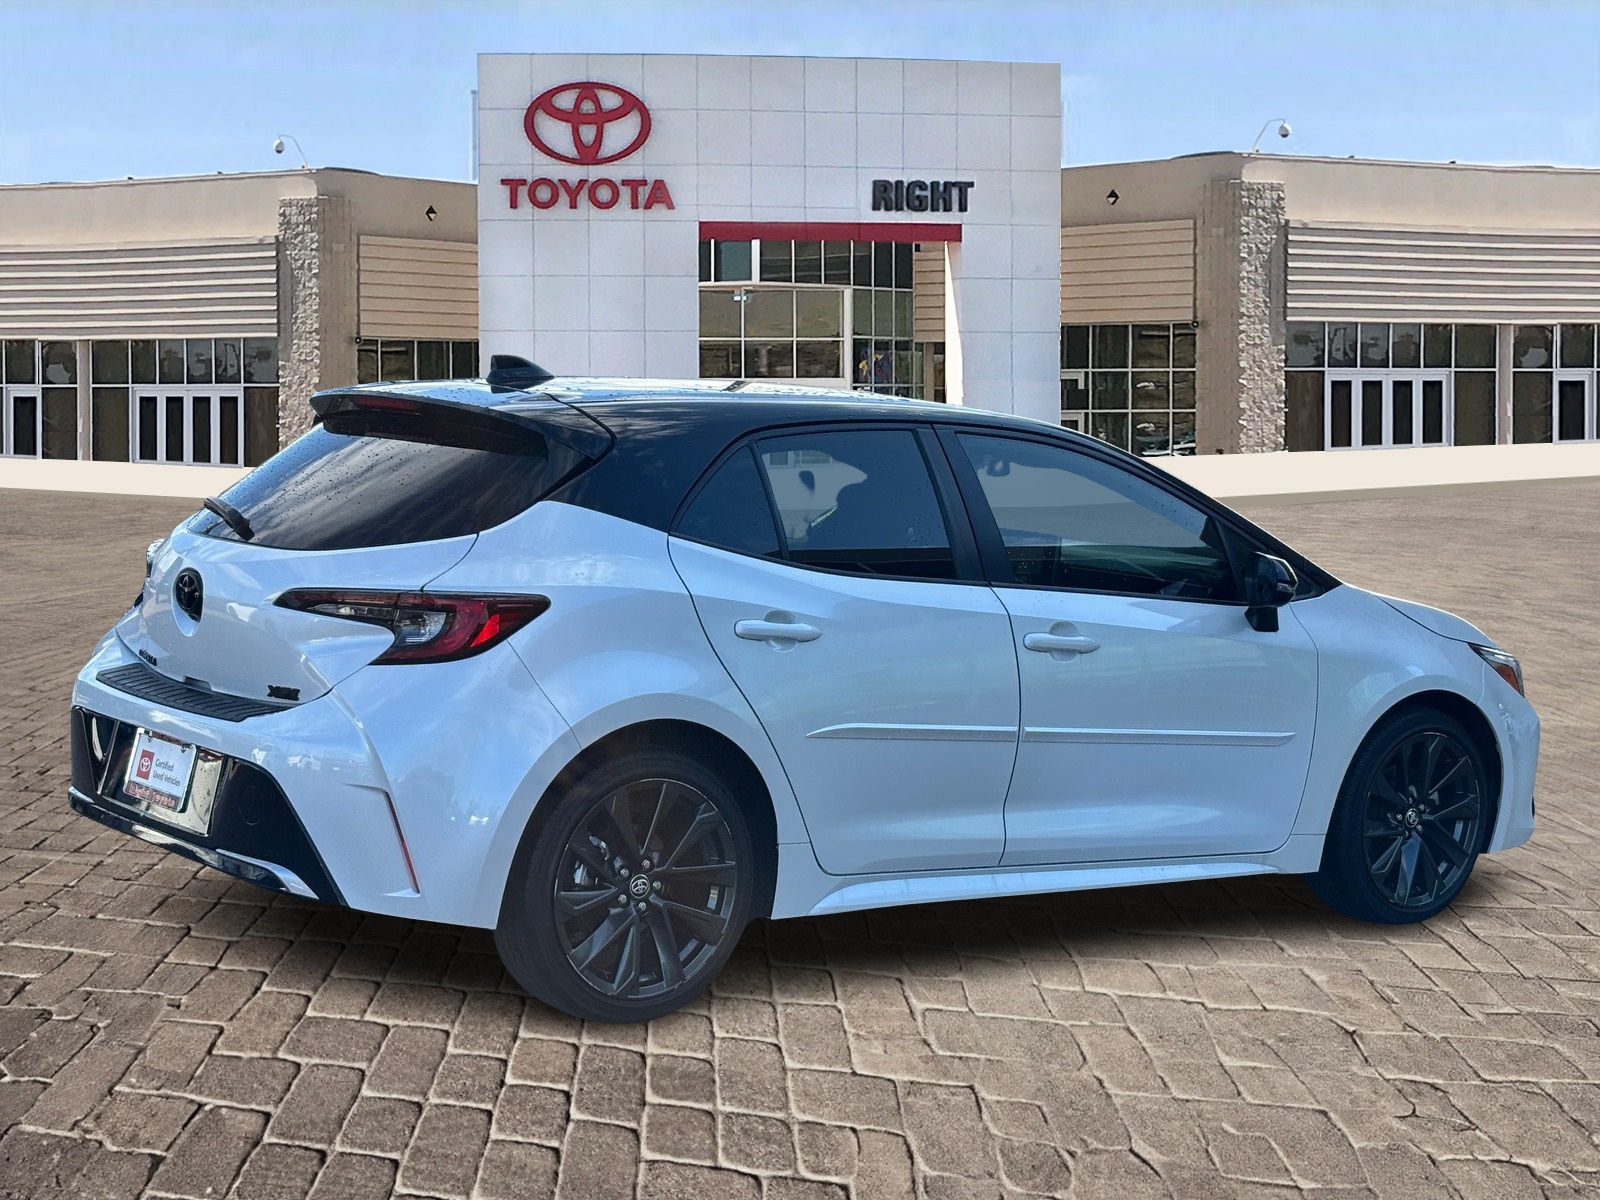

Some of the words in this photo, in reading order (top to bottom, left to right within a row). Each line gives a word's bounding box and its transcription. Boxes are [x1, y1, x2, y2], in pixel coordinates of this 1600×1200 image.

[500, 178, 675, 211] TOYOTA
[871, 179, 975, 213] RIGHT
[155, 758, 175, 772] Certified
[153, 770, 164, 781] Used
[164, 773, 181, 787] Vehicles
